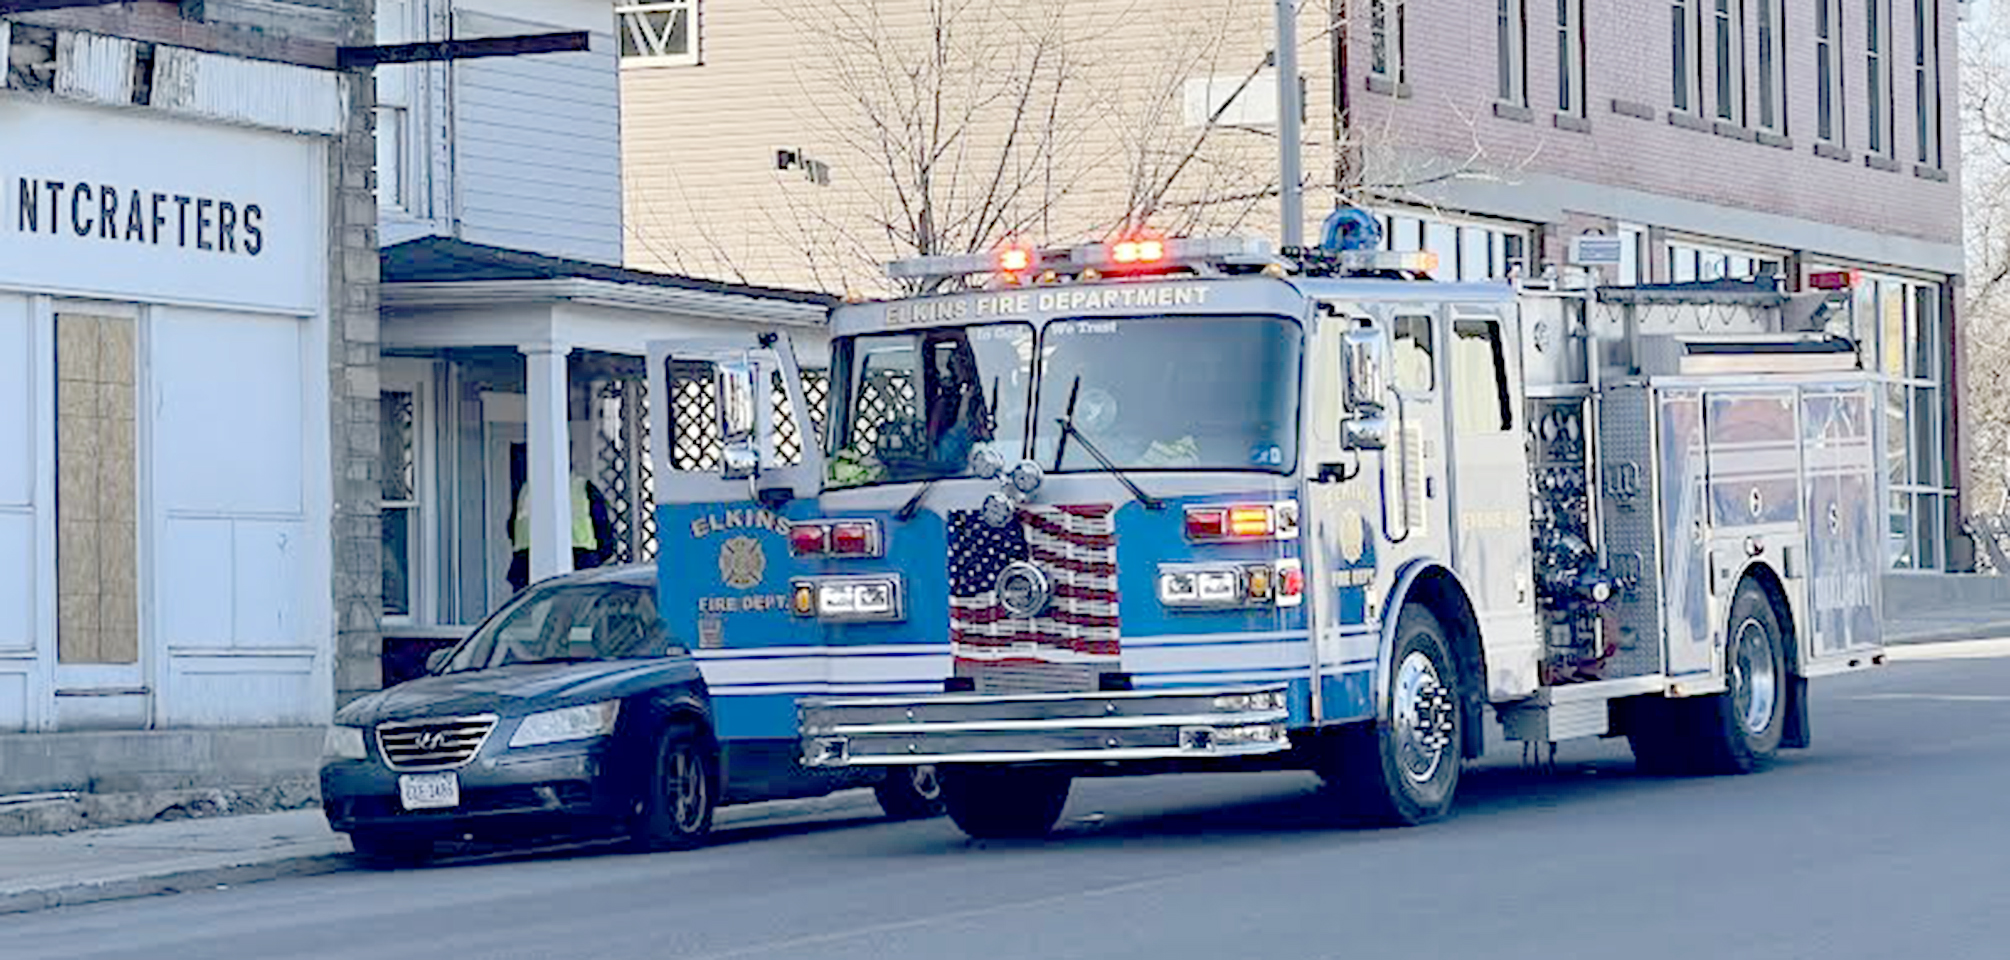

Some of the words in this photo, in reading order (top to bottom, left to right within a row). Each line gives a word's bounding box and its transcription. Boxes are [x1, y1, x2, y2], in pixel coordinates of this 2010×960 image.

[886, 300, 967, 325] ELKINS
[976, 296, 1030, 317] FIRE
[1037, 286, 1210, 312] DEPARTMENT
[1051, 321, 1075, 336] We
[1078, 321, 1118, 335] Trust
[691, 509, 792, 538] ELKINS
[698, 597, 738, 613] FIRE
